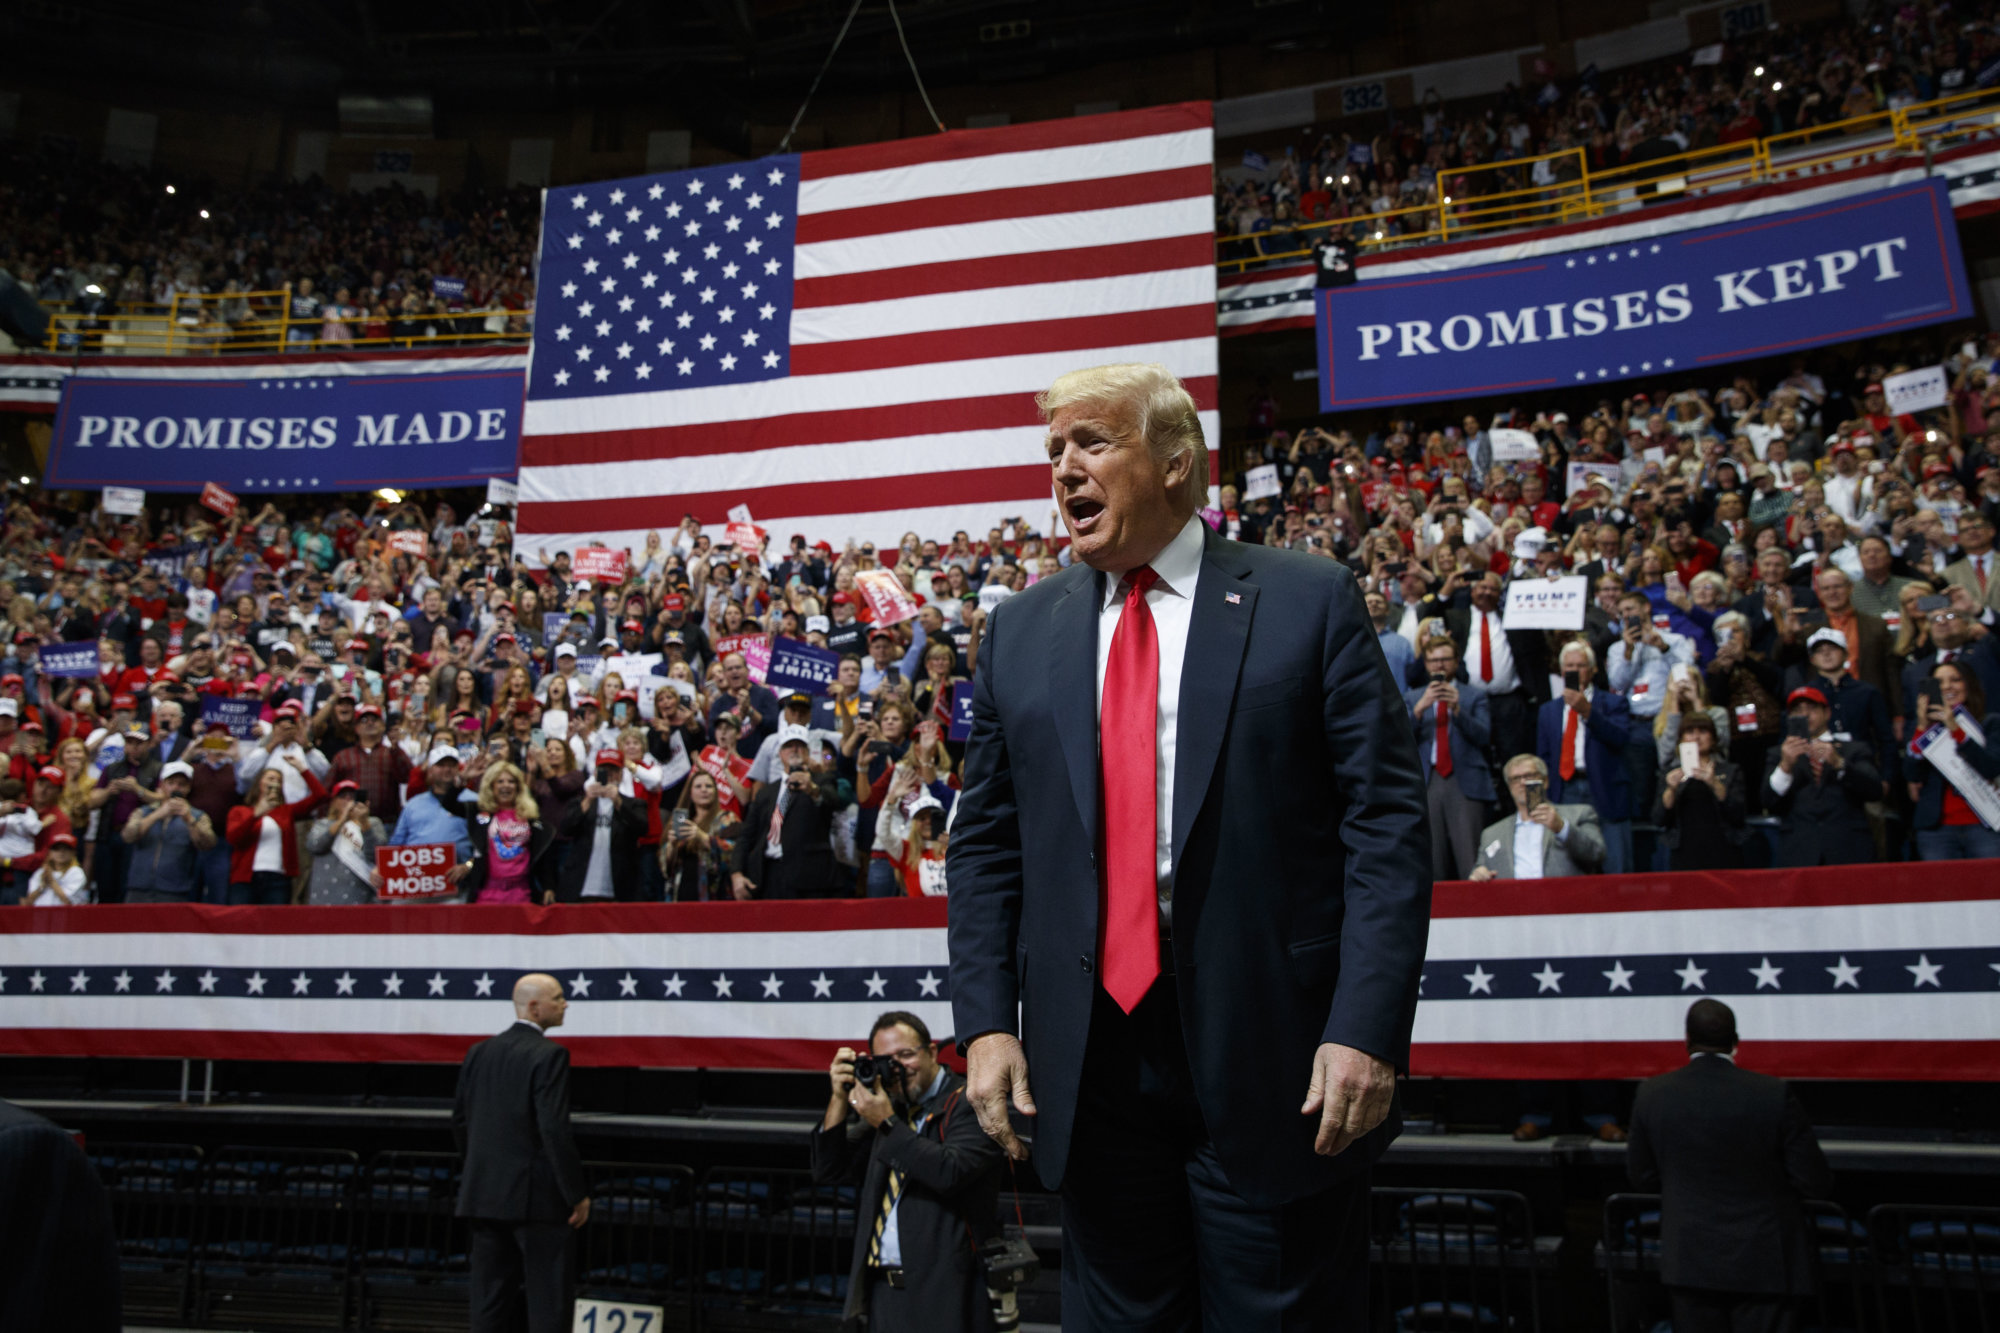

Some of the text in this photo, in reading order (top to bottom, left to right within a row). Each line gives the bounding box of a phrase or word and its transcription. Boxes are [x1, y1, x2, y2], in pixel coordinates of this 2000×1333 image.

[1344, 84, 1382, 111] 332
[1356, 237, 1908, 361] PROMISES KEPT
[75, 409, 508, 450] PROMISES MADE
[1515, 592, 1578, 602] TRUMP
[717, 637, 745, 652] GET
[773, 663, 833, 685] TRUMP
[219, 703, 249, 714] KEEP
[387, 847, 446, 867] JOBS
[387, 875, 447, 894] MOBS
[582, 1306, 653, 1333] 127
